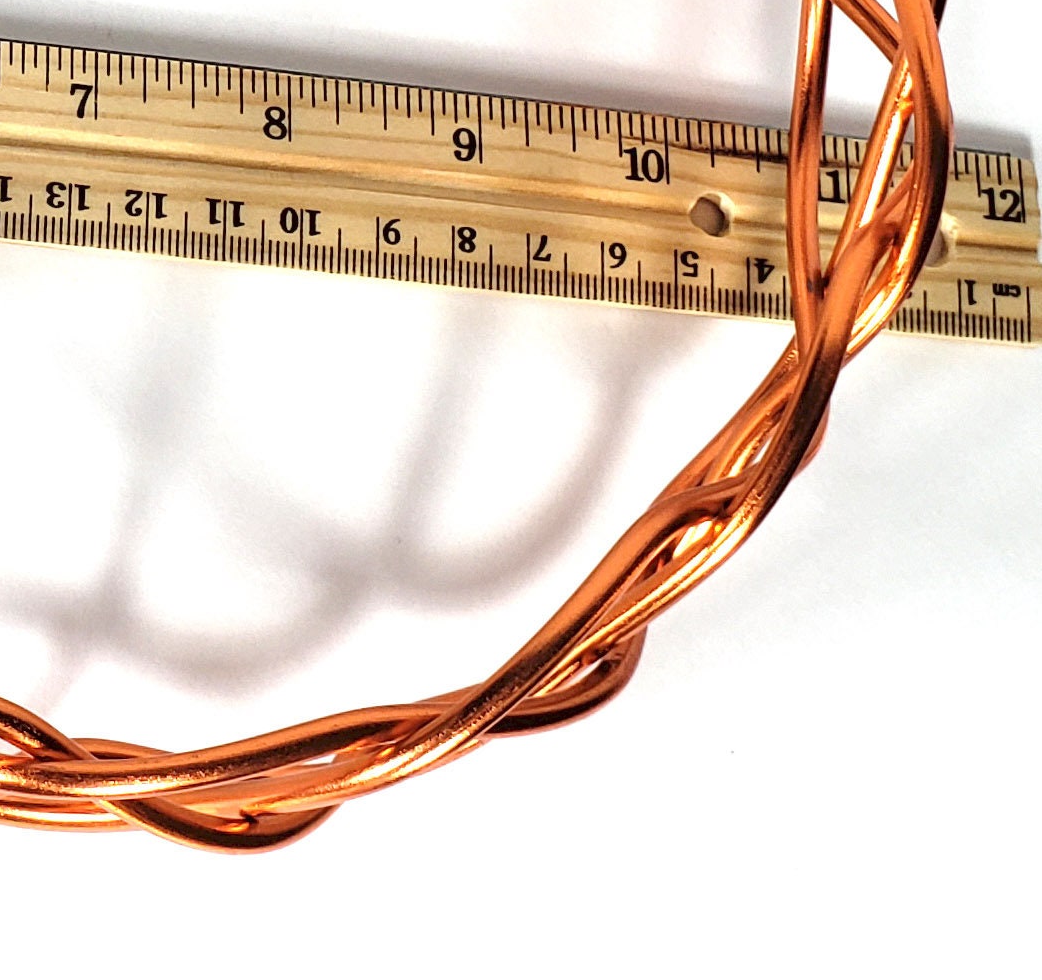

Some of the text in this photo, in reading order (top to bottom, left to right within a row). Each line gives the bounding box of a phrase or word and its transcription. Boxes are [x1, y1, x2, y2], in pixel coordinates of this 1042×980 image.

[70, 84, 93, 118] 7
[263, 107, 287, 139] 8
[453, 128, 476, 161] 9
[624, 148, 664, 182] 10
[981, 188, 1021, 222] 12
[46, 182, 90, 210] 13
[125, 190, 167, 218] 12
[205, 198, 245, 227] 11
[280, 207, 320, 236] 10
[383, 219, 400, 244] 9
[458, 227, 476, 252] 8
[533, 235, 551, 261] 7
[609, 243, 627, 268] 6
[681, 251, 699, 277] 5
[754, 258, 774, 283] 4
[965, 280, 976, 305] 1
[992, 282, 1020, 297] cm
